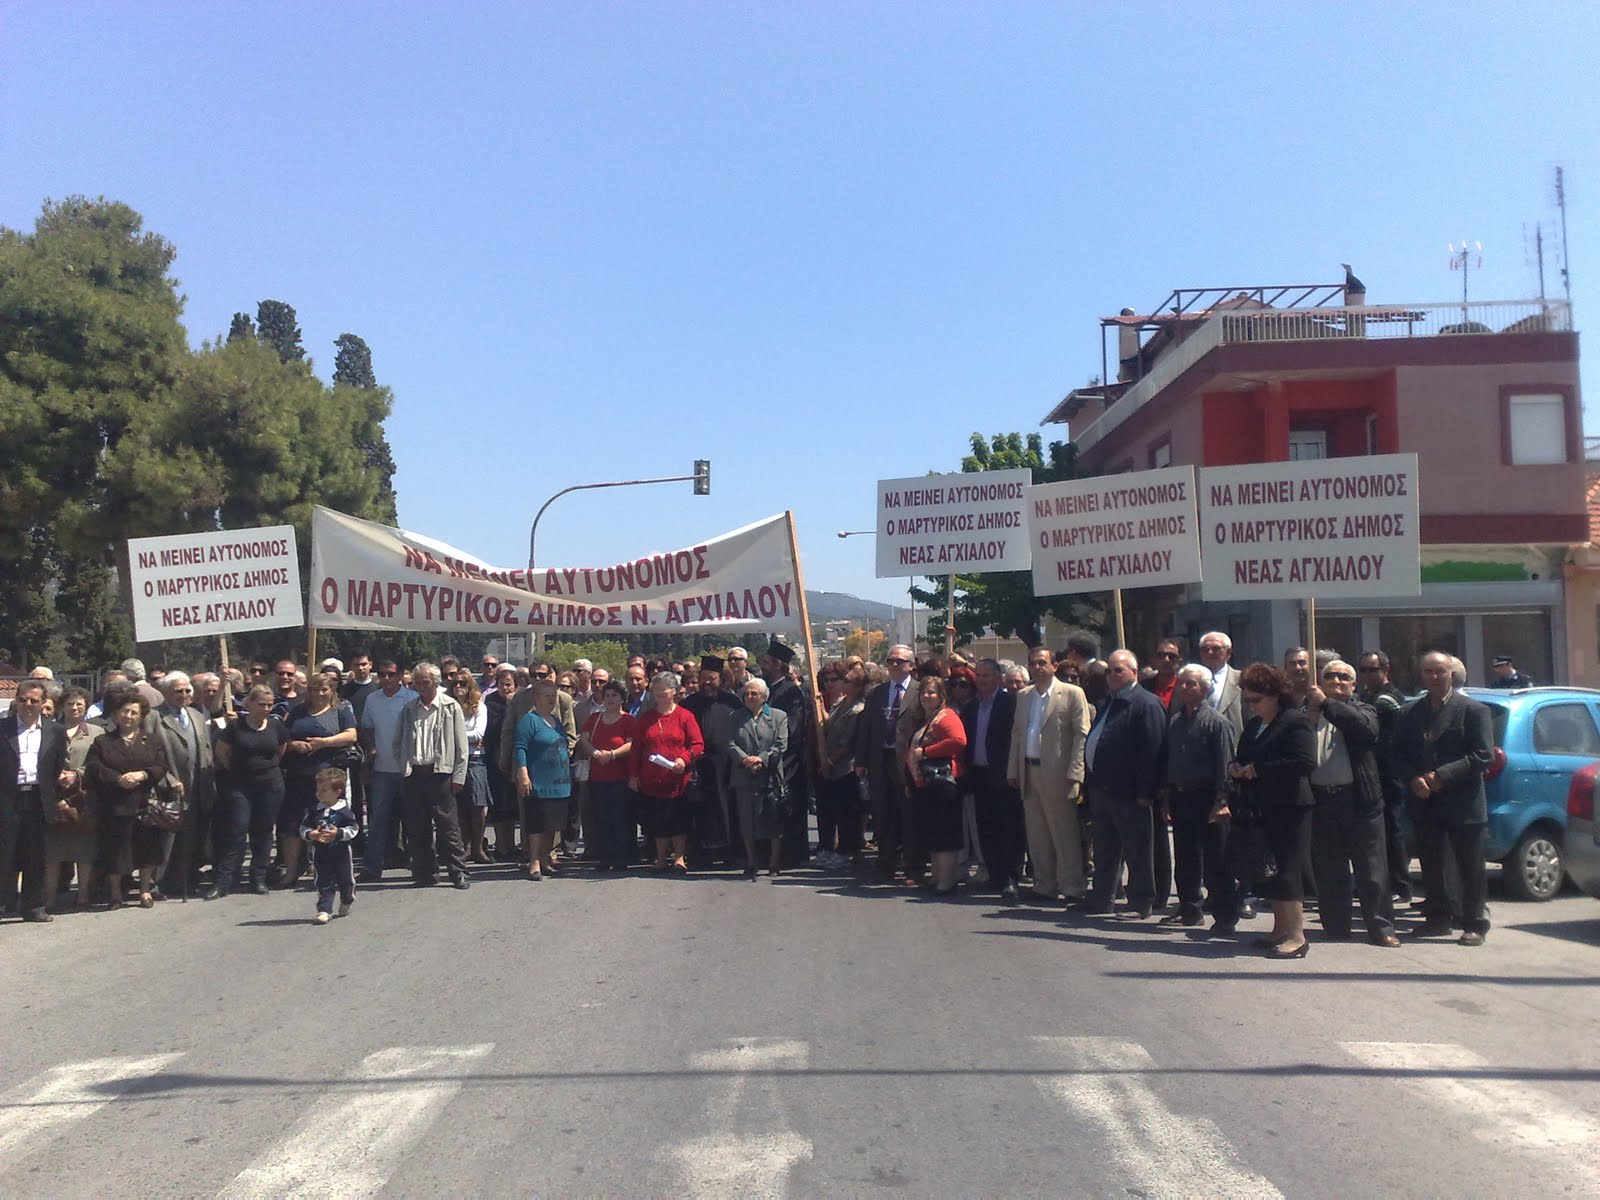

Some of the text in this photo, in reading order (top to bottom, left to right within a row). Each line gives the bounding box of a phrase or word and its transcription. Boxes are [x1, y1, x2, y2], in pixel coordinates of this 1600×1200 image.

[885, 483, 1023, 508] ΝΑ ΜΕΙΝΕΙ ΑΥΤΟΝΟΜΟΣ
[1035, 482, 1186, 518] ΝΑ ΜΕΙΝΕΙ ΑΥΤΟΝΟΜΟΣ
[1211, 474, 1407, 506] ΝΑ ΜΕΙΝΕΙ ΑΥΤΟΝΟΜΟΣ
[887, 512, 1020, 535] Ο ΜΑΡΤΥΡΙΚΟΣ ΔΗΜΟΣ
[1040, 515, 1185, 548] Ο ΜΑΡΤΥΡΙΚΟΣ ΔΗΜΟΣ
[1215, 514, 1404, 544] Ο ΜΑΡΤΥΡΙΚΟΣ ΔΗΜΟΣ
[139, 540, 288, 568] ΝΑ ΜΕΙΝΕΙ ΑΥΤΟΝΟΜΟΣ
[900, 541, 1006, 564] ΝΕΑΣ ΑΓΧΙΑΛΟΥ
[1058, 550, 1172, 581] ΝΕΑΣ ΑΓΧΙΑΛΟΥ
[144, 568, 288, 597] Ο ΜΑΡΤΥΡΙΚΟΣ ΔΗΜΟΣ
[403, 545, 441, 574] ΝΑ
[545, 545, 710, 594] ΑΥΤΟΝΟΜΟΣ
[1235, 555, 1384, 584] ΝΕΑΣ ΑΓΧΙΑΛΟΥ
[162, 598, 276, 627] ΝΕΑΣ ΑΓΧΙΑΛΟΥ
[322, 577, 791, 626] Ο ΜΑΡΤΥΡΙΚΟΣ ΔΗΜΟΣ Ν. ΑΓΧΙΑΛΟΥ
